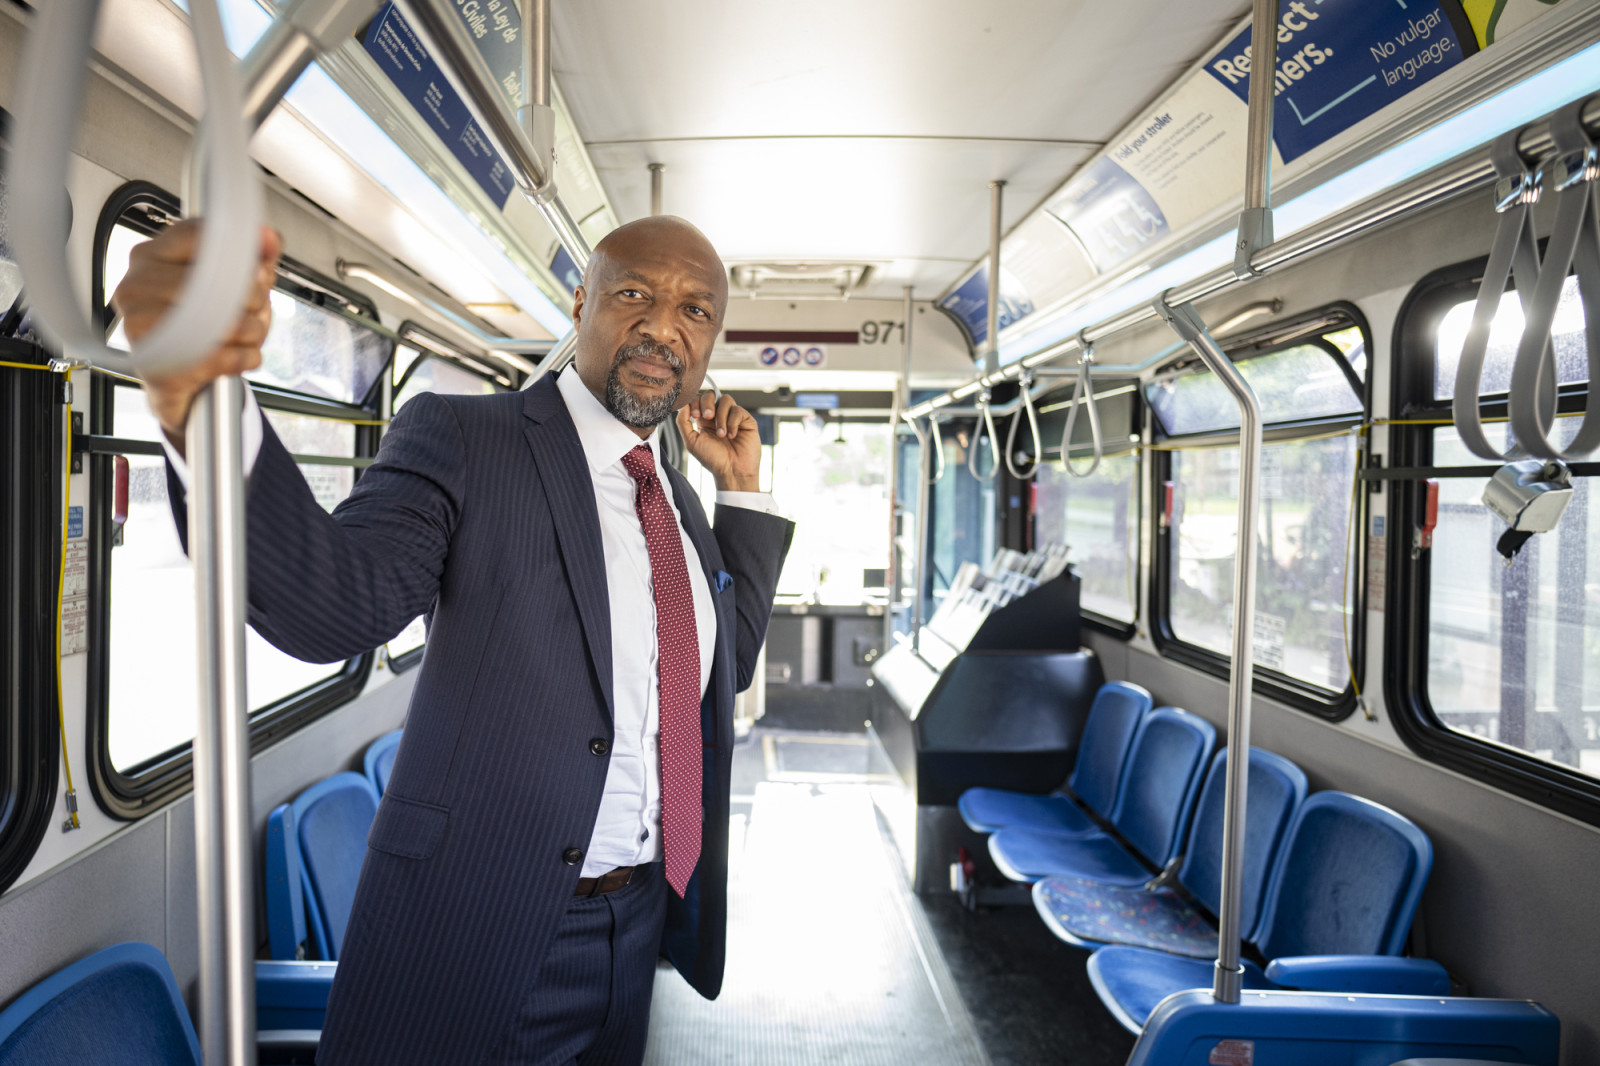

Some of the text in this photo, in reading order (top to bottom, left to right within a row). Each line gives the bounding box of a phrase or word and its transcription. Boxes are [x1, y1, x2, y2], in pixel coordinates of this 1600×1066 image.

[462, 1, 488, 39] Civiles
[487, 0, 519, 43] la Ley de
[1213, 1, 1319, 84] Reect
[1370, 8, 1441, 63] No vulgar
[1381, 37, 1455, 87] language.
[1113, 113, 1173, 161] Fold your stroller
[862, 320, 905, 344] 971
